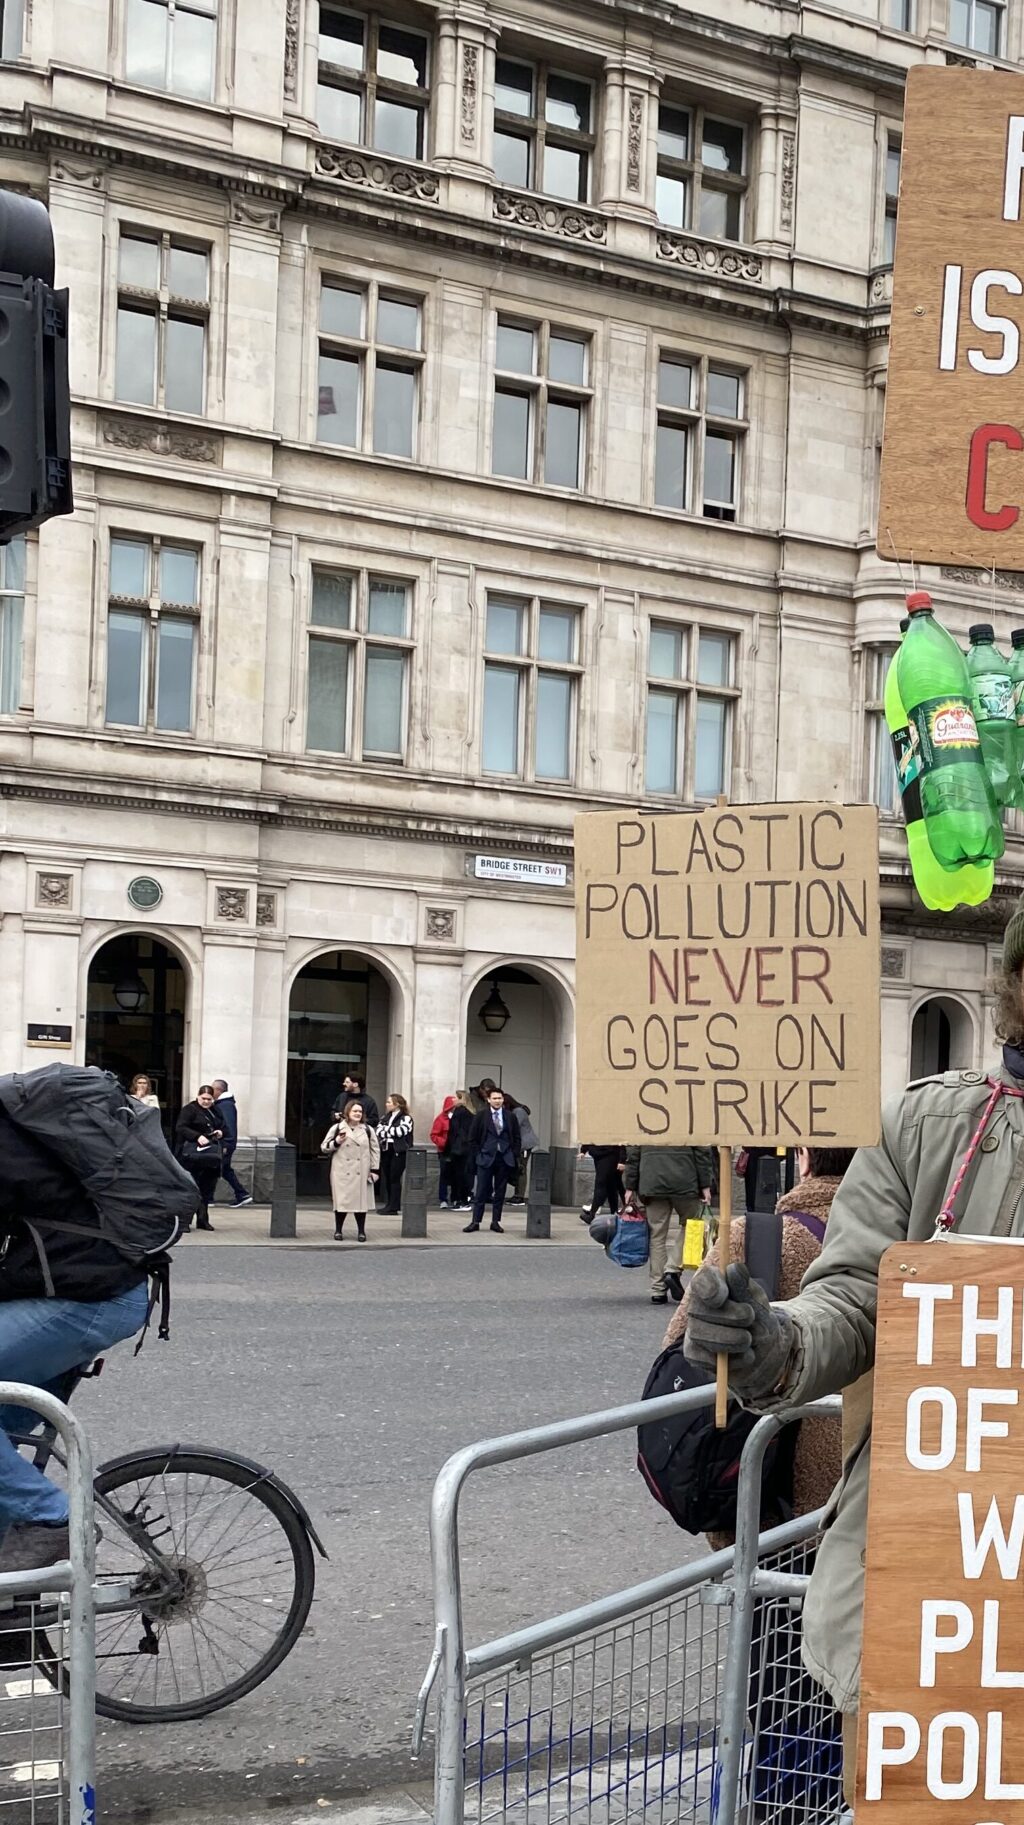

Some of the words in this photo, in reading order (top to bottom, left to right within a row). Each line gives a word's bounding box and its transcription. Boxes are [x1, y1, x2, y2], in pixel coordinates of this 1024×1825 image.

[938, 264, 1024, 376] IS
[480, 858, 511, 870] BRIDGE
[513, 862, 542, 873] STREET
[544, 865, 562, 876] SW1
[616, 809, 845, 876] PLASTIC
[585, 878, 868, 941] POLLUTION
[649, 944, 834, 1007] NEVER
[606, 1012, 741, 1072] GOES
[775, 1012, 846, 1072] ON
[636, 1077, 838, 1138] STRIKE
[905, 1385, 1019, 1473] OF
